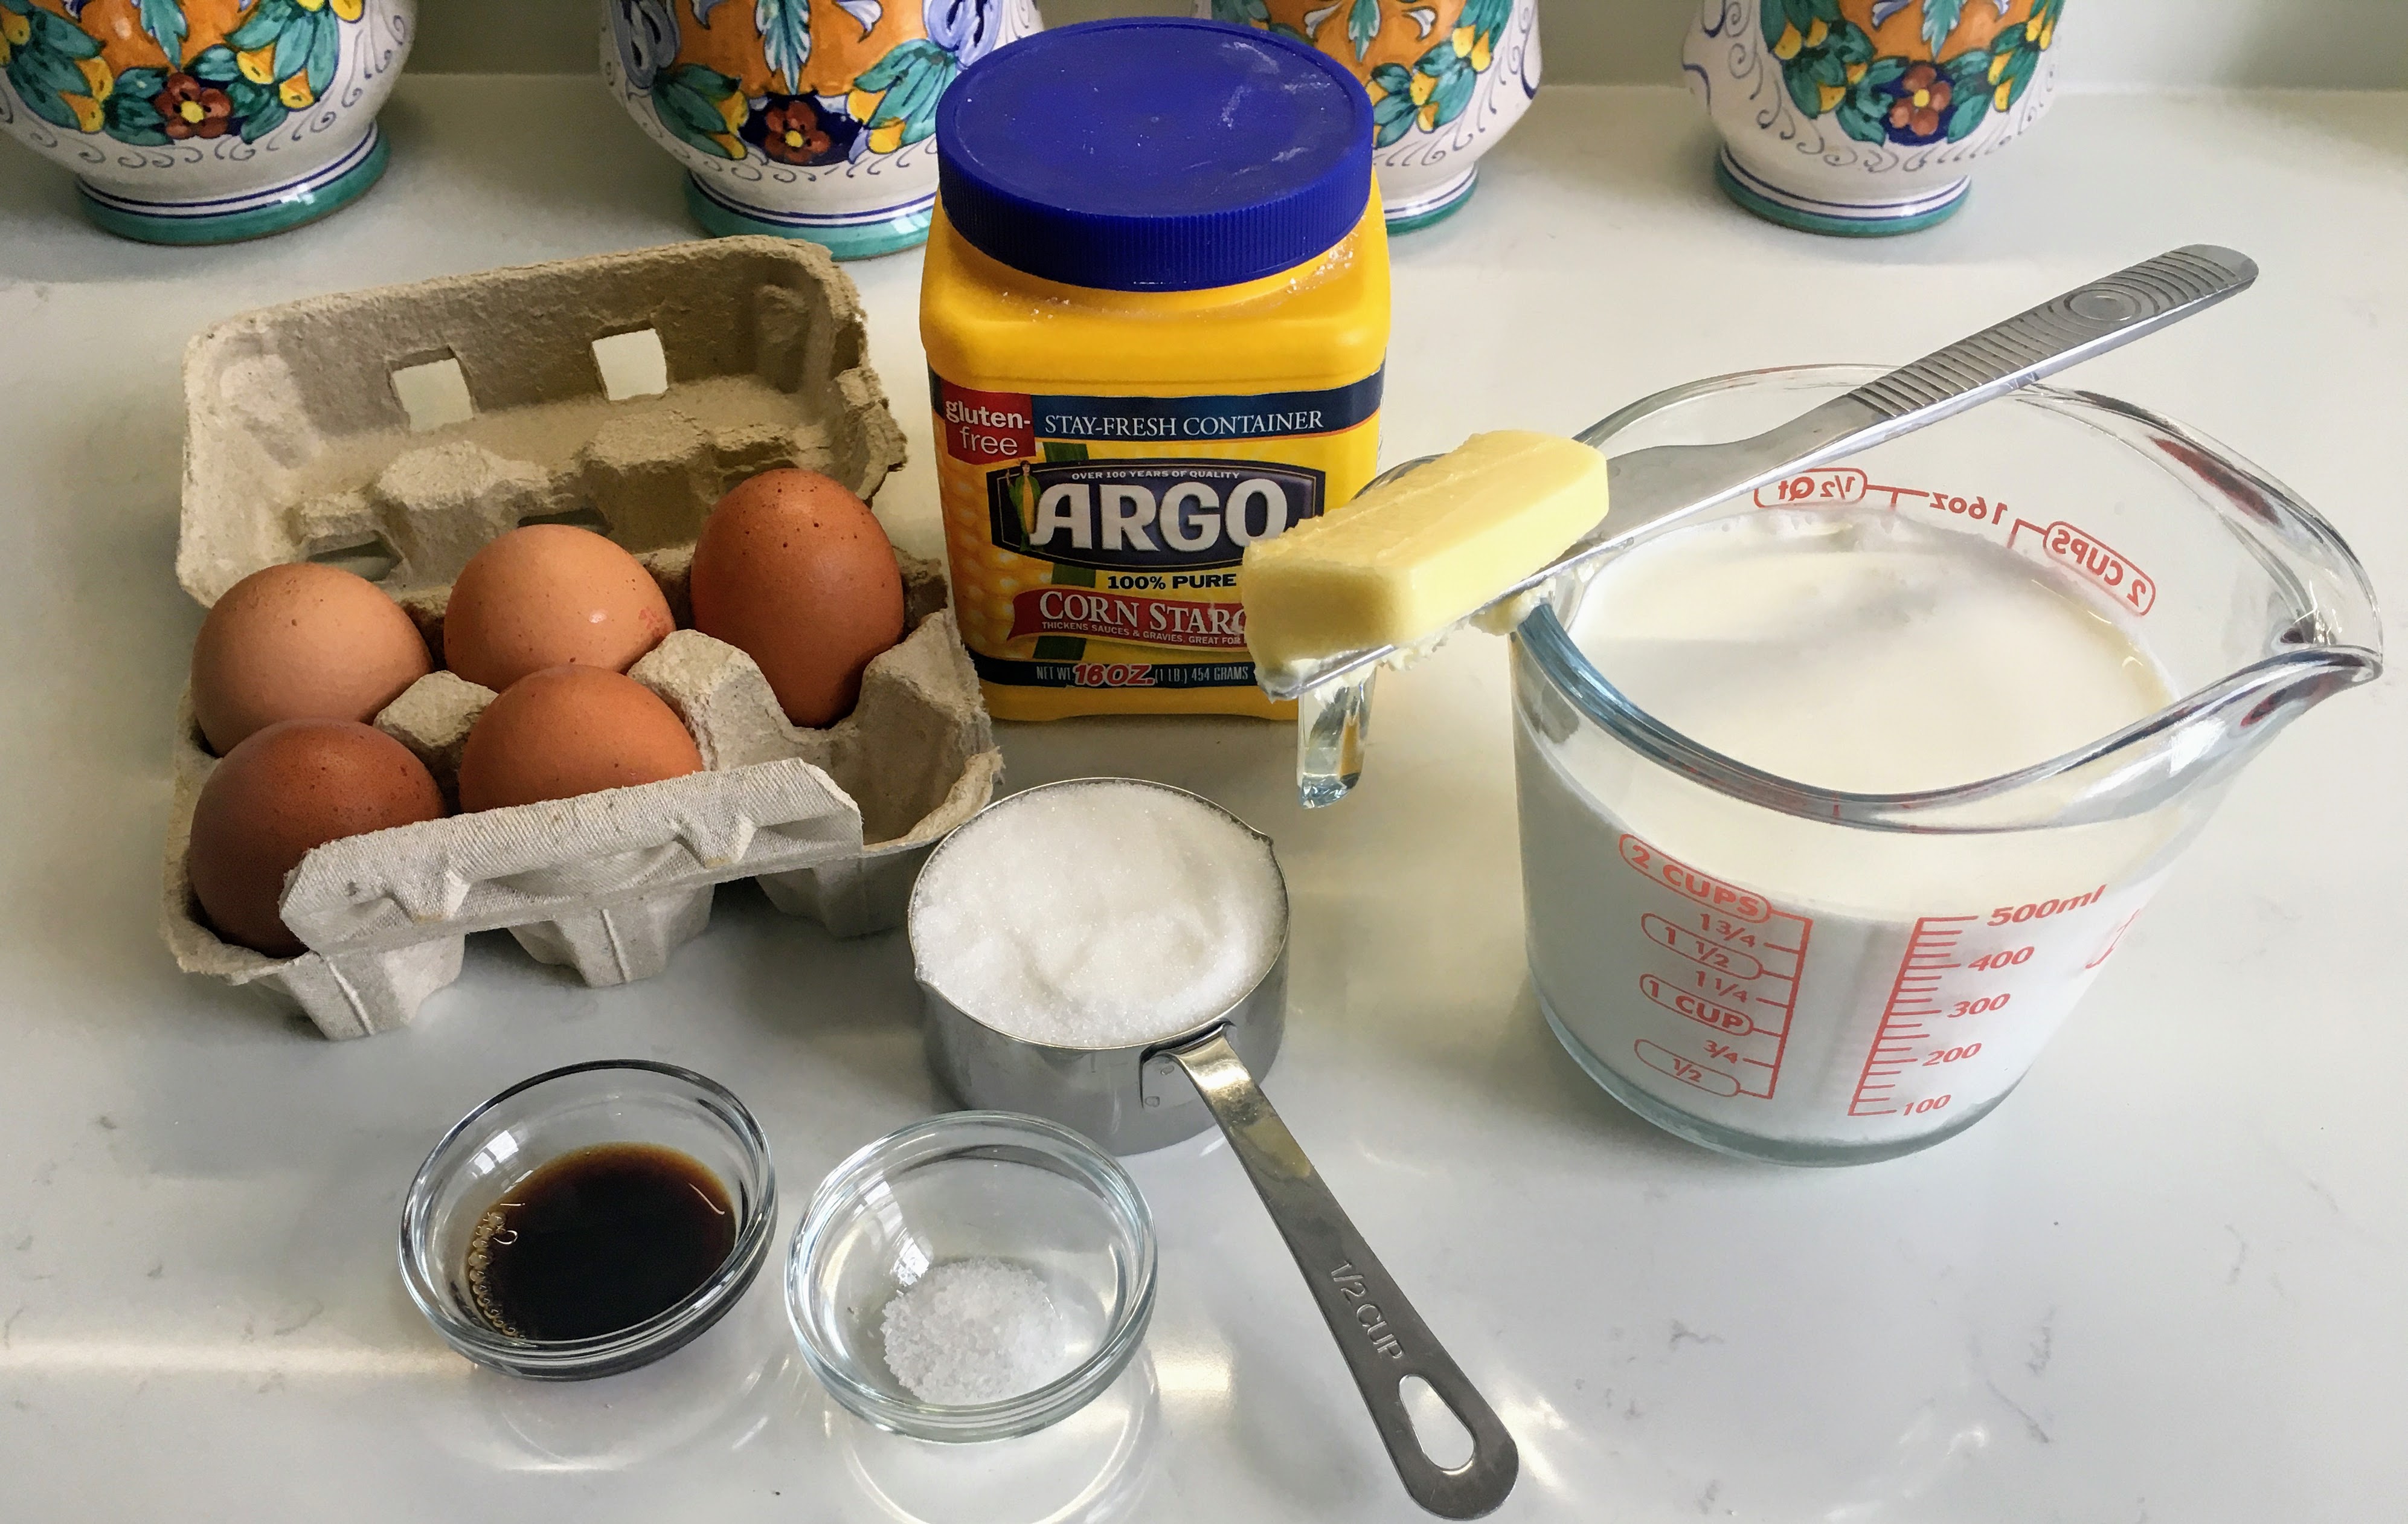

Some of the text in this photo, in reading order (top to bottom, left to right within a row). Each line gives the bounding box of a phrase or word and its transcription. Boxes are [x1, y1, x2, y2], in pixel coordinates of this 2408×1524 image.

[945, 400, 1030, 429] gluten-
[1045, 411, 1324, 436] STAY-FRESH CONTAINER
[959, 426, 1018, 455] free
[1071, 471, 1103, 480] OVER
[1029, 478, 1287, 553] ARGO
[1108, 573, 1236, 590] 100% PURE
[1039, 590, 1245, 635] CORN STARC
[1042, 621, 1088, 631] THICKENS
[1091, 624, 1129, 635] SAUCES
[1189, 636, 1218, 645] GREAT
[1036, 666, 1053, 680] NET
[1191, 667, 1209, 681] 454
[1214, 666, 1248, 681] GRAMS
[1632, 844, 1759, 917] 2 CUPS
[1987, 884, 2107, 926] 500ml
[1968, 946, 2035, 971] 400
[1649, 979, 1744, 1028] 1 CUP
[1947, 993, 2011, 1018] 300
[1703, 1040, 1738, 1064] 3/4
[1922, 1043, 1982, 1066] 200
[1673, 1058, 1702, 1082] 1/2
[1903, 1095, 1951, 1116] 100
[1331, 1260, 1405, 1359] 1/2 CUP
